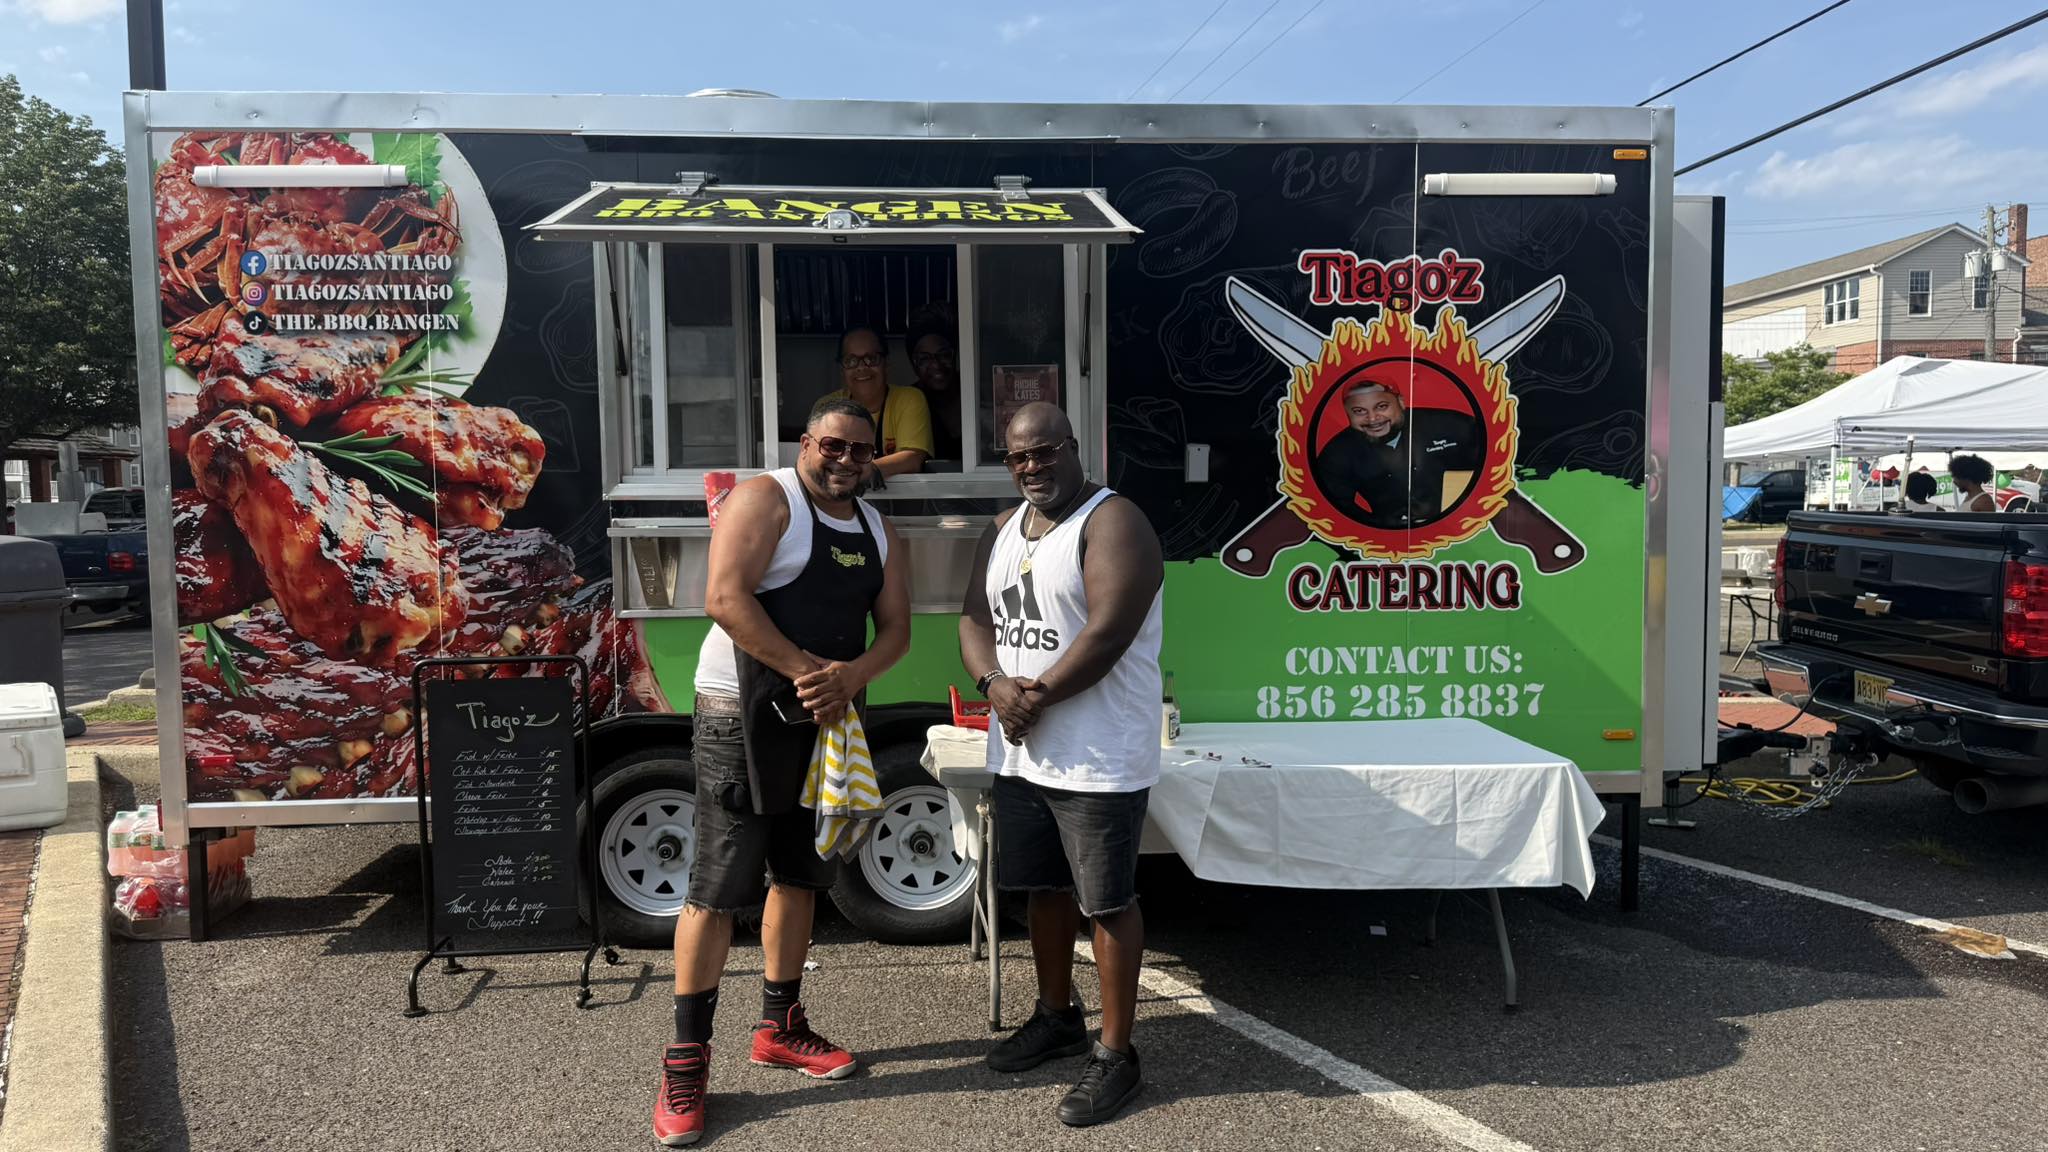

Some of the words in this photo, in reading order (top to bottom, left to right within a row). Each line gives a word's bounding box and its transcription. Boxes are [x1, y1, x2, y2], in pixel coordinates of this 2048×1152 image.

[607, 199, 1066, 213] BANGEN
[271, 254, 452, 272] TIAGOZSANTIAGO
[272, 284, 453, 301] TIAGOZSANTIAGO
[1300, 250, 1483, 312] Tiago'z
[272, 314, 459, 331] THE.BBQ.BANGEN
[1288, 565, 1522, 611] CATERING
[994, 617, 1060, 651] didas
[1285, 647, 1453, 676] CONTACT
[1464, 646, 1523, 674] US:
[1257, 685, 1336, 719] 856
[1350, 685, 1426, 718] 285
[1441, 683, 1545, 717] 8837
[445, 893, 477, 914] Thank
